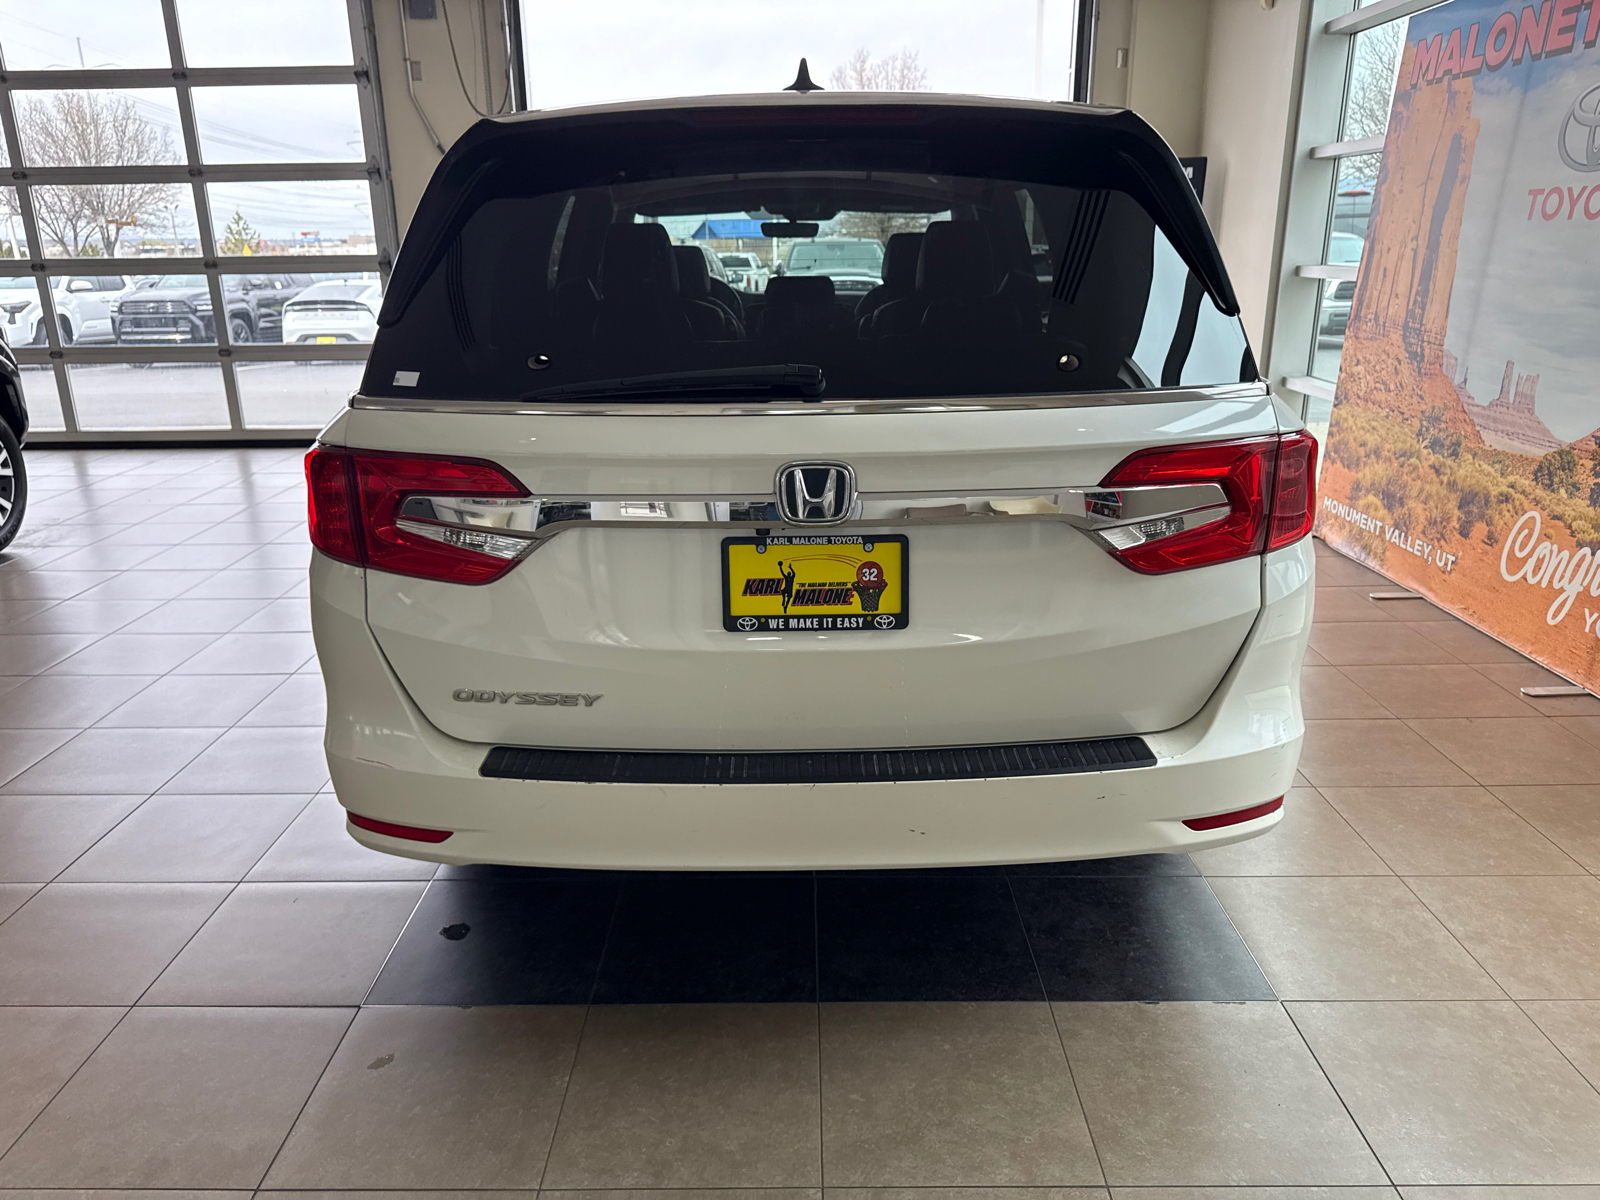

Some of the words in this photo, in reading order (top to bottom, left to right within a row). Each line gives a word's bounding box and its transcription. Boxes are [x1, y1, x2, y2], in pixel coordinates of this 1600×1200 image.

[792, 537, 828, 545] MALONE
[831, 536, 863, 544] TOYOTA
[1322, 495, 1383, 536] MONUMENT
[1385, 524, 1432, 565] VALLEY,
[1435, 549, 1456, 572] UT
[862, 568, 878, 581] 32
[742, 578, 784, 596] KARL
[791, 588, 854, 607] MALONE
[768, 618, 785, 629] WE
[788, 618, 819, 629] MAKE
[823, 618, 833, 628] IT
[836, 617, 864, 628] EASY
[452, 687, 604, 707] ODYSSEY
